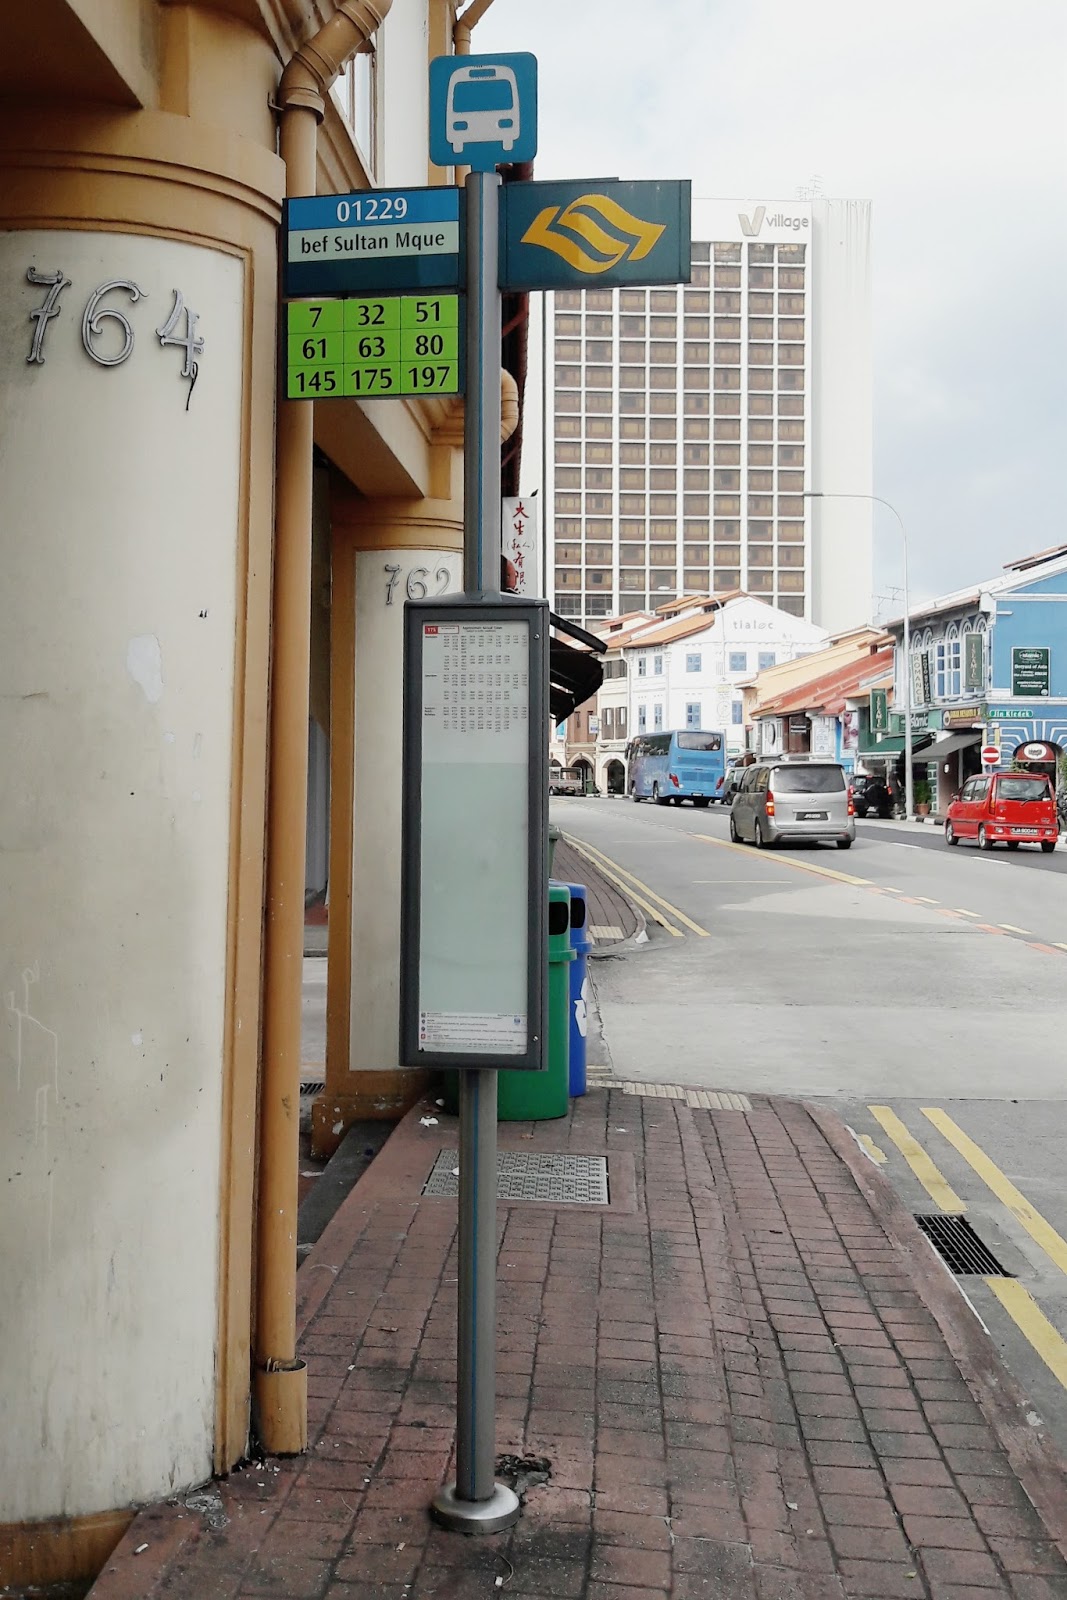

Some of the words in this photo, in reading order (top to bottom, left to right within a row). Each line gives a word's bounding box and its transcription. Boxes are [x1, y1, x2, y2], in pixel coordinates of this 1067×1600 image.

[337, 198, 408, 223] 01229
[766, 214, 809, 231] village
[301, 235, 328, 254] bef
[334, 233, 389, 252] Sultan
[395, 231, 445, 251] Mque
[26, 265, 206, 378] 764
[309, 307, 322, 328] 7
[358, 305, 385, 326] 32
[416, 301, 441, 323] 51
[302, 338, 327, 359] 61
[358, 336, 385, 358] 63
[415, 334, 443, 355] 80
[296, 371, 336, 393] 145
[351, 368, 393, 390] 175
[408, 366, 451, 388] 197
[384, 564, 452, 605] 762
[913, 656, 922, 702] ROMANCE
